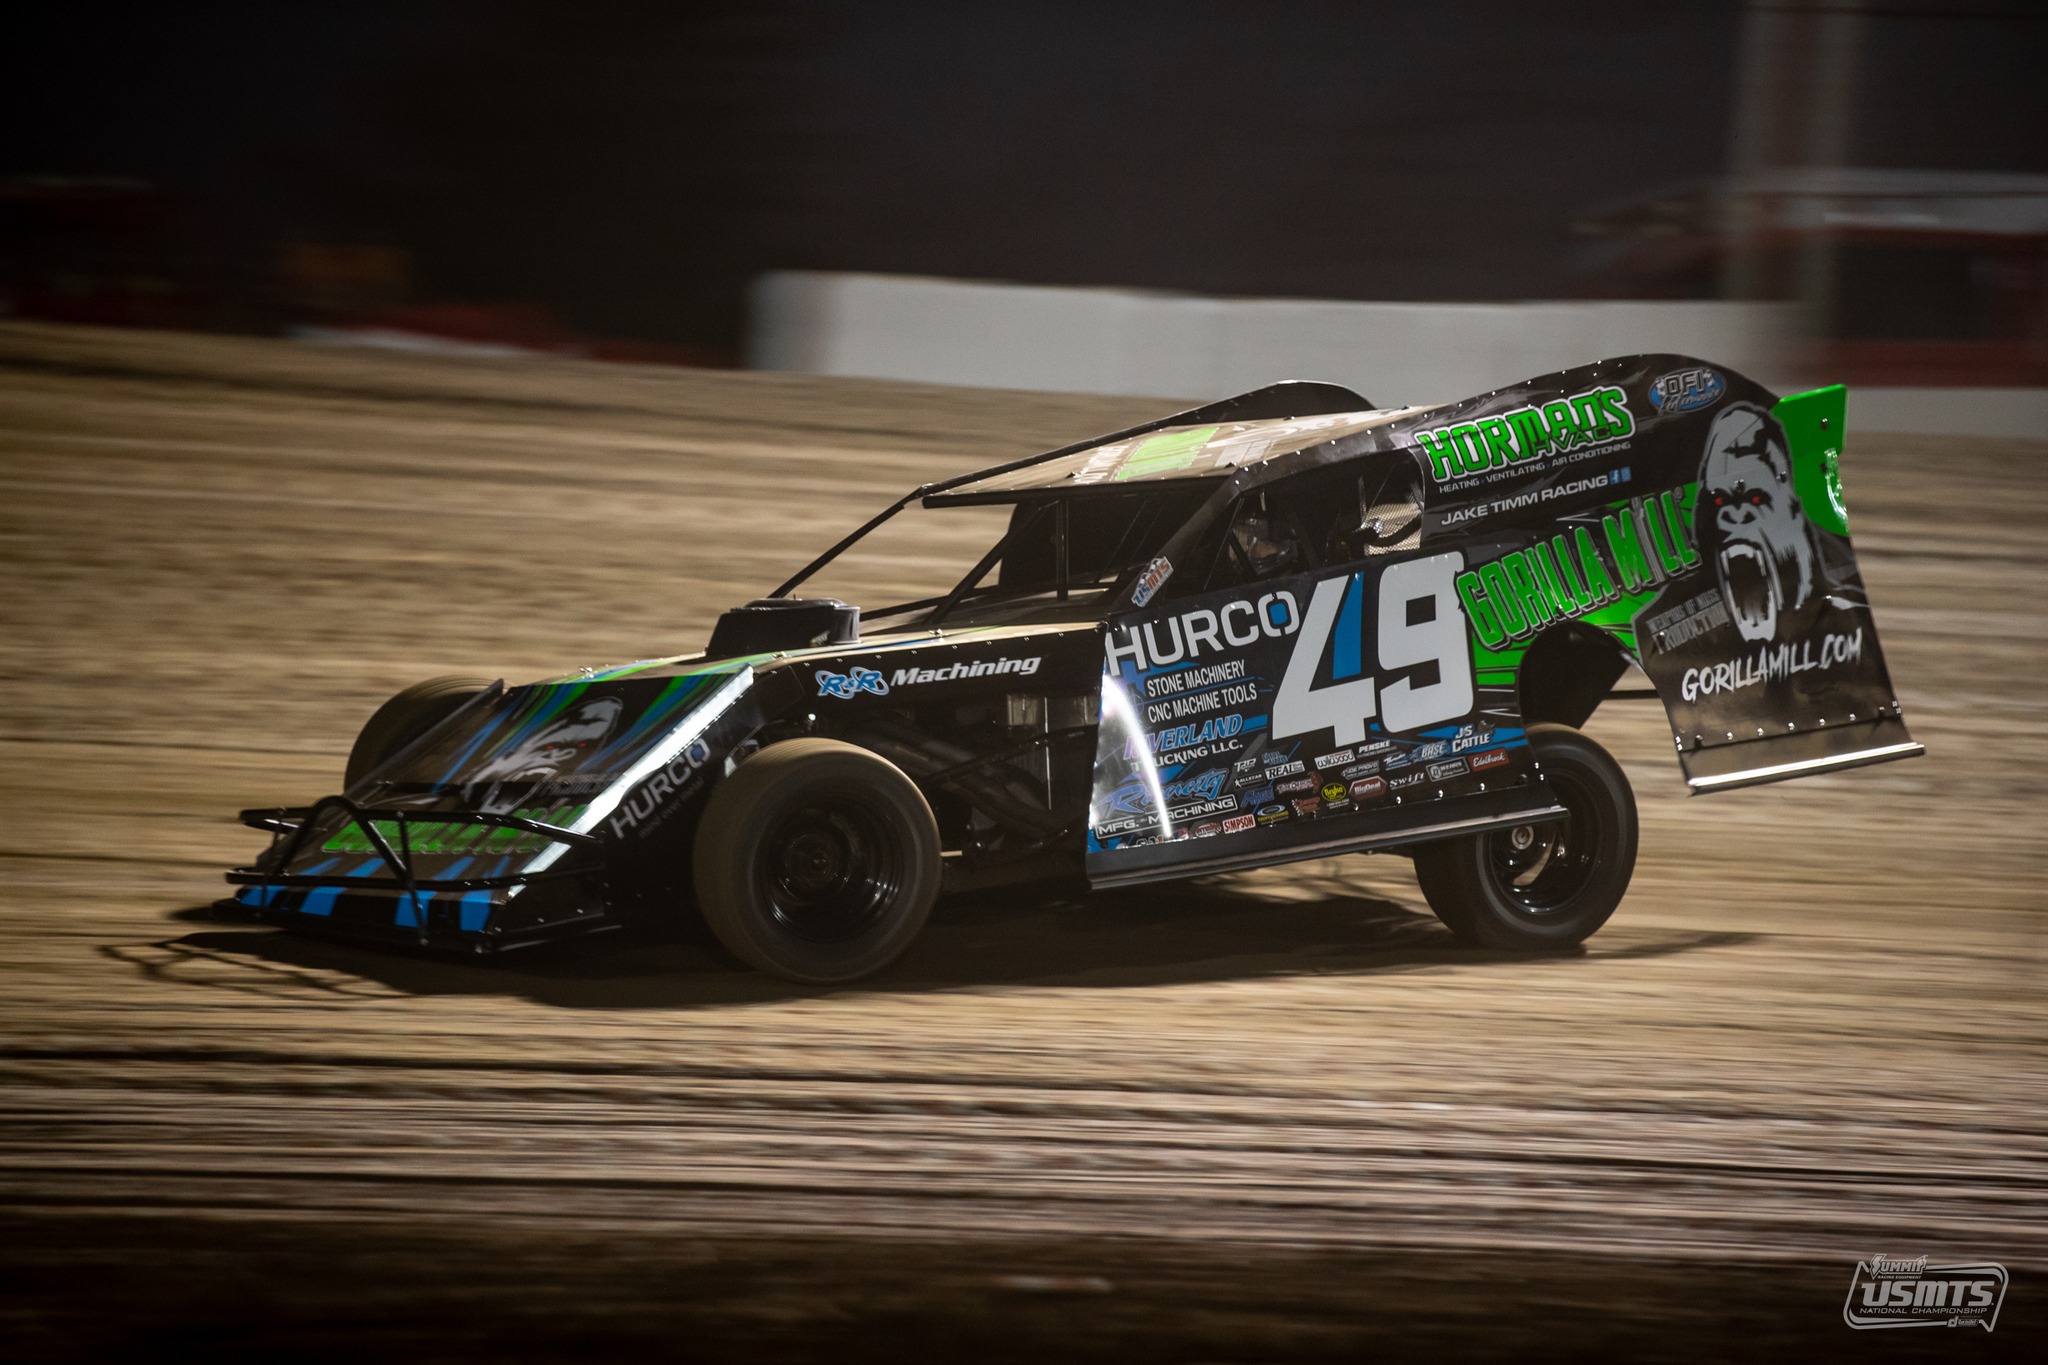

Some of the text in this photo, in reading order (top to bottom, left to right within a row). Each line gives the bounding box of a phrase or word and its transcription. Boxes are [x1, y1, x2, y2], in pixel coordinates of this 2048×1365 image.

[1531, 424, 1612, 457] HVAC
[1439, 441, 1632, 494] HEATING VENTILATING AIR CONDITIONING
[1441, 475, 1609, 526] JAKE TIMM RACING
[1455, 525, 1621, 650] GORILLA
[1104, 590, 1301, 677] HURCO
[1272, 550, 1475, 748] 49
[890, 656, 1042, 687] Machining
[1147, 659, 1246, 698] STONE MACHINERY
[1681, 627, 1863, 703] GORILLAMILL.COM
[1148, 683, 1258, 724] CNC MACHINE TOOLS
[1123, 713, 1243, 761] RVERLAND
[1358, 740, 1391, 754] PENSKE
[1452, 732, 1491, 753] CATTLE
[1455, 724, 1473, 739] JS
[1131, 739, 1244, 771] TUCKING LLC.
[608, 737, 711, 840] HURCO
[1390, 772, 1425, 788] Swift
[1098, 818, 1140, 836] MFG.
[1223, 814, 1255, 833] SIMPSON
